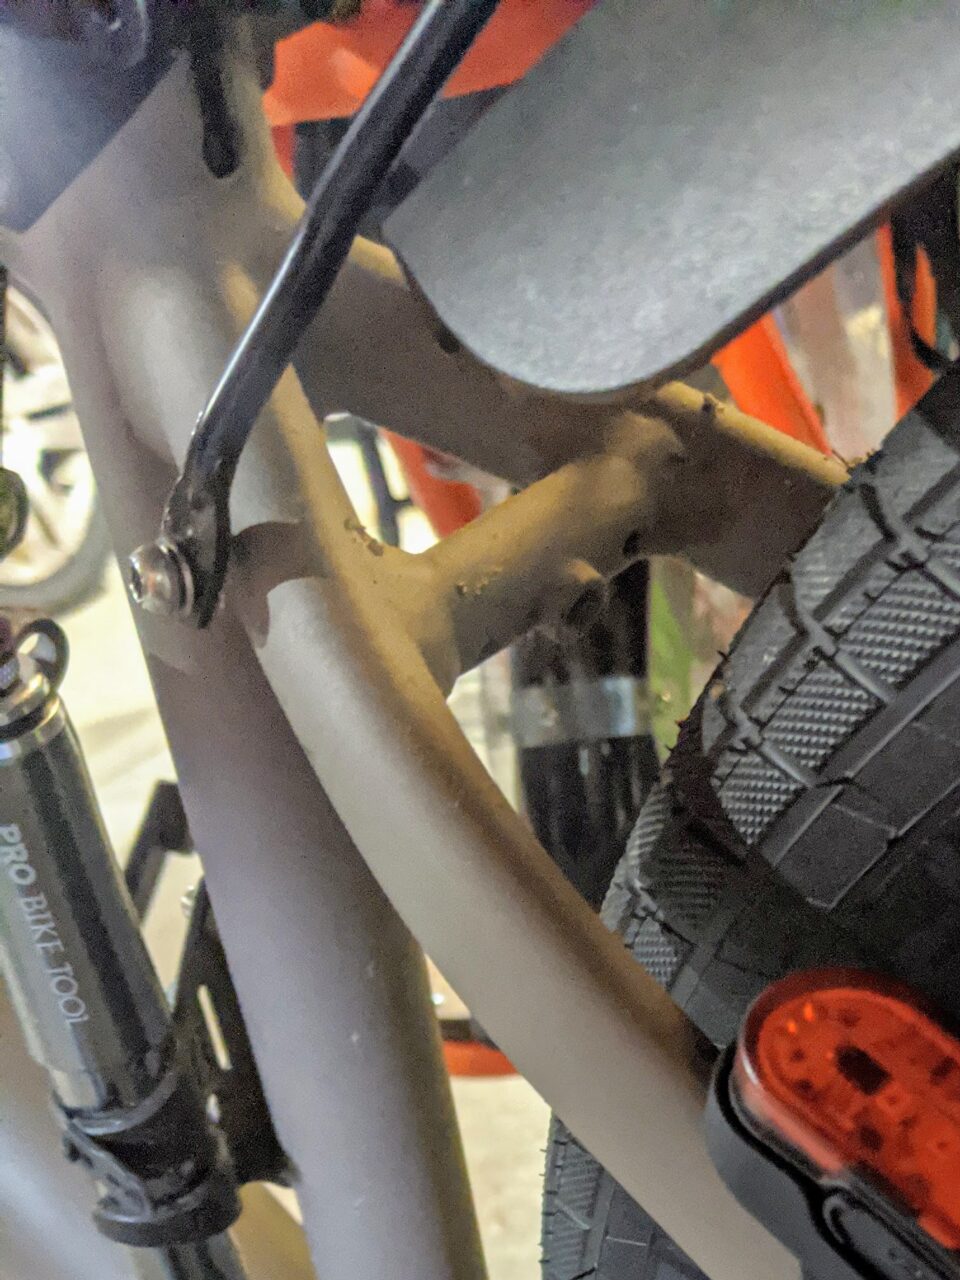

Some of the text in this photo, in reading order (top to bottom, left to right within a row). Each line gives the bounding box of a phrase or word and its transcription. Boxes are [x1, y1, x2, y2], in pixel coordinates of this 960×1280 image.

[0, 822, 89, 1027] PRO BIKE TOOL
